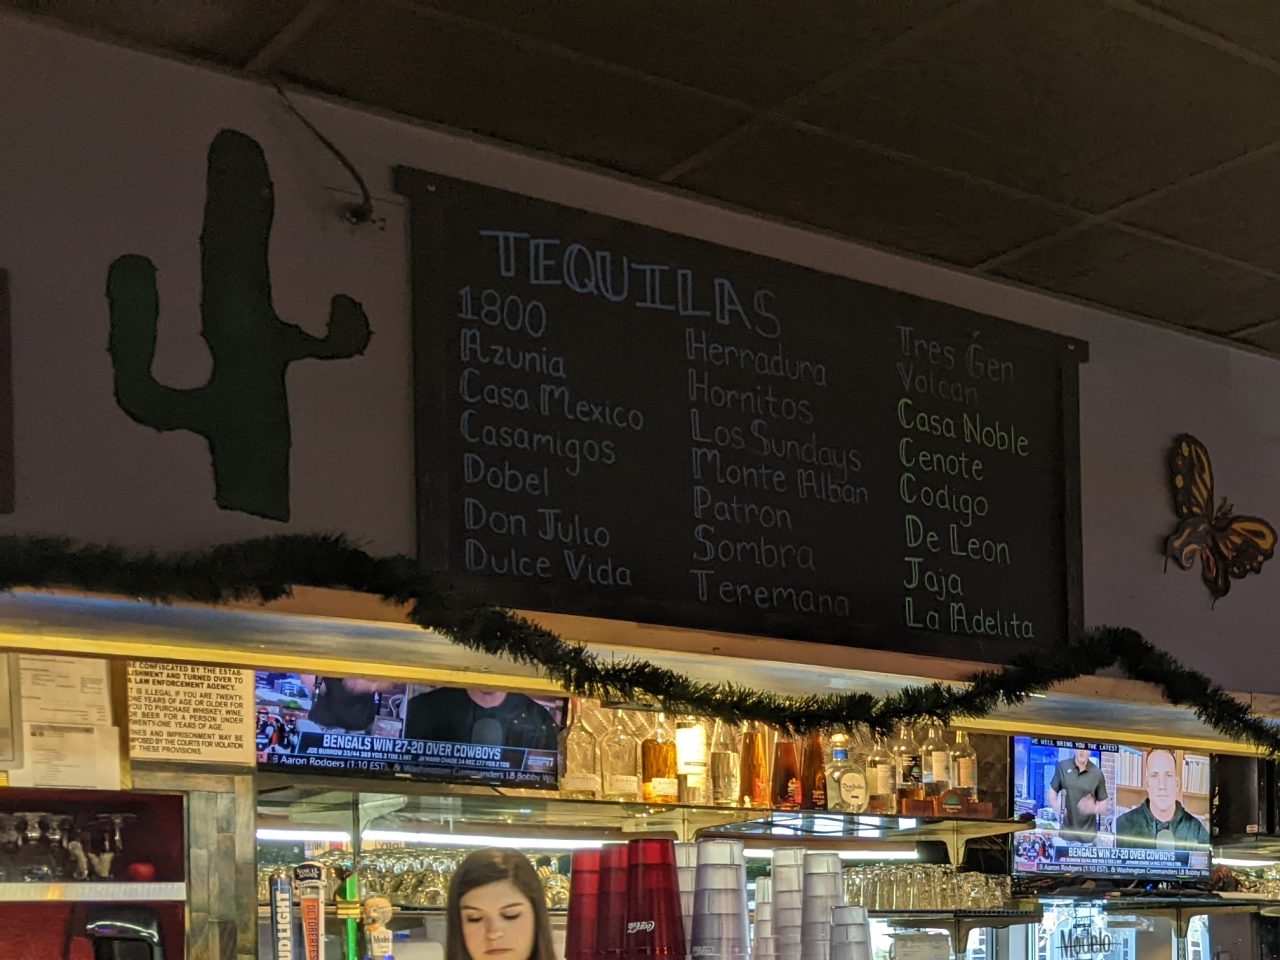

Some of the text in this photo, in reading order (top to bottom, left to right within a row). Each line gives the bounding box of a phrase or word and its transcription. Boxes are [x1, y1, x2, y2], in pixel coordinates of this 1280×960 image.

[479, 229, 781, 339] TEQUILAS
[458, 285, 547, 338] 1800
[460, 327, 567, 379] Azunia
[685, 327, 827, 388] Herradura
[897, 326, 956, 370] Tres
[459, 368, 645, 431] Casa Mexico
[688, 368, 814, 424] Hornitos
[897, 362, 979, 405] Volcan
[460, 408, 617, 477] Casamigos
[690, 408, 862, 484] Los Sundays
[898, 397, 1030, 457] Casa Noble
[463, 452, 550, 497] Dobel
[691, 447, 868, 504] Monte Alban
[899, 437, 985, 481] Cenote
[464, 497, 610, 547] Don Julio
[692, 485, 793, 529] Patron
[900, 472, 989, 528] Codigo
[692, 524, 816, 571] Sombra
[905, 514, 1011, 565] De Leon
[465, 538, 632, 587] Dulce Vida
[903, 556, 965, 601] Jaja
[688, 570, 851, 617] Teremana
[905, 597, 1035, 640] La Adelita
[139, 662, 188, 672] CONFISCATED
[191, 664, 199, 673] BY
[203, 665, 217, 674] THE
[152, 679, 204, 689] ENFORCEMENT
[183, 673, 211, 682] TURNED
[214, 675, 232, 683] OVER
[144, 696, 166, 704] YEARS
[179, 698, 192, 706] AGE
[206, 700, 228, 708] OLDER
[230, 701, 243, 709] FOR
[155, 705, 190, 713] PURCHASE
[164, 712, 177, 720] FOR
[190, 714, 217, 722] PERSON
[220, 716, 243, 724] UNDER
[174, 720, 196, 729] YEARS
[177, 739, 200, 747] COURTS
[219, 733, 231, 741] MAY
[323, 734, 501, 760] BENGALS WIN 27-20 OVER COWBOYS
[281, 754, 307, 764] Aaron
[309, 757, 345, 768] Rodgers
[1068, 847, 1175, 861] BENGALS WIN 27-20 OVER COWBOYS
[276, 890, 291, 939] LIGHT
[307, 904, 319, 960] OCTOBERFES
[1060, 927, 1110, 959] Modelo
